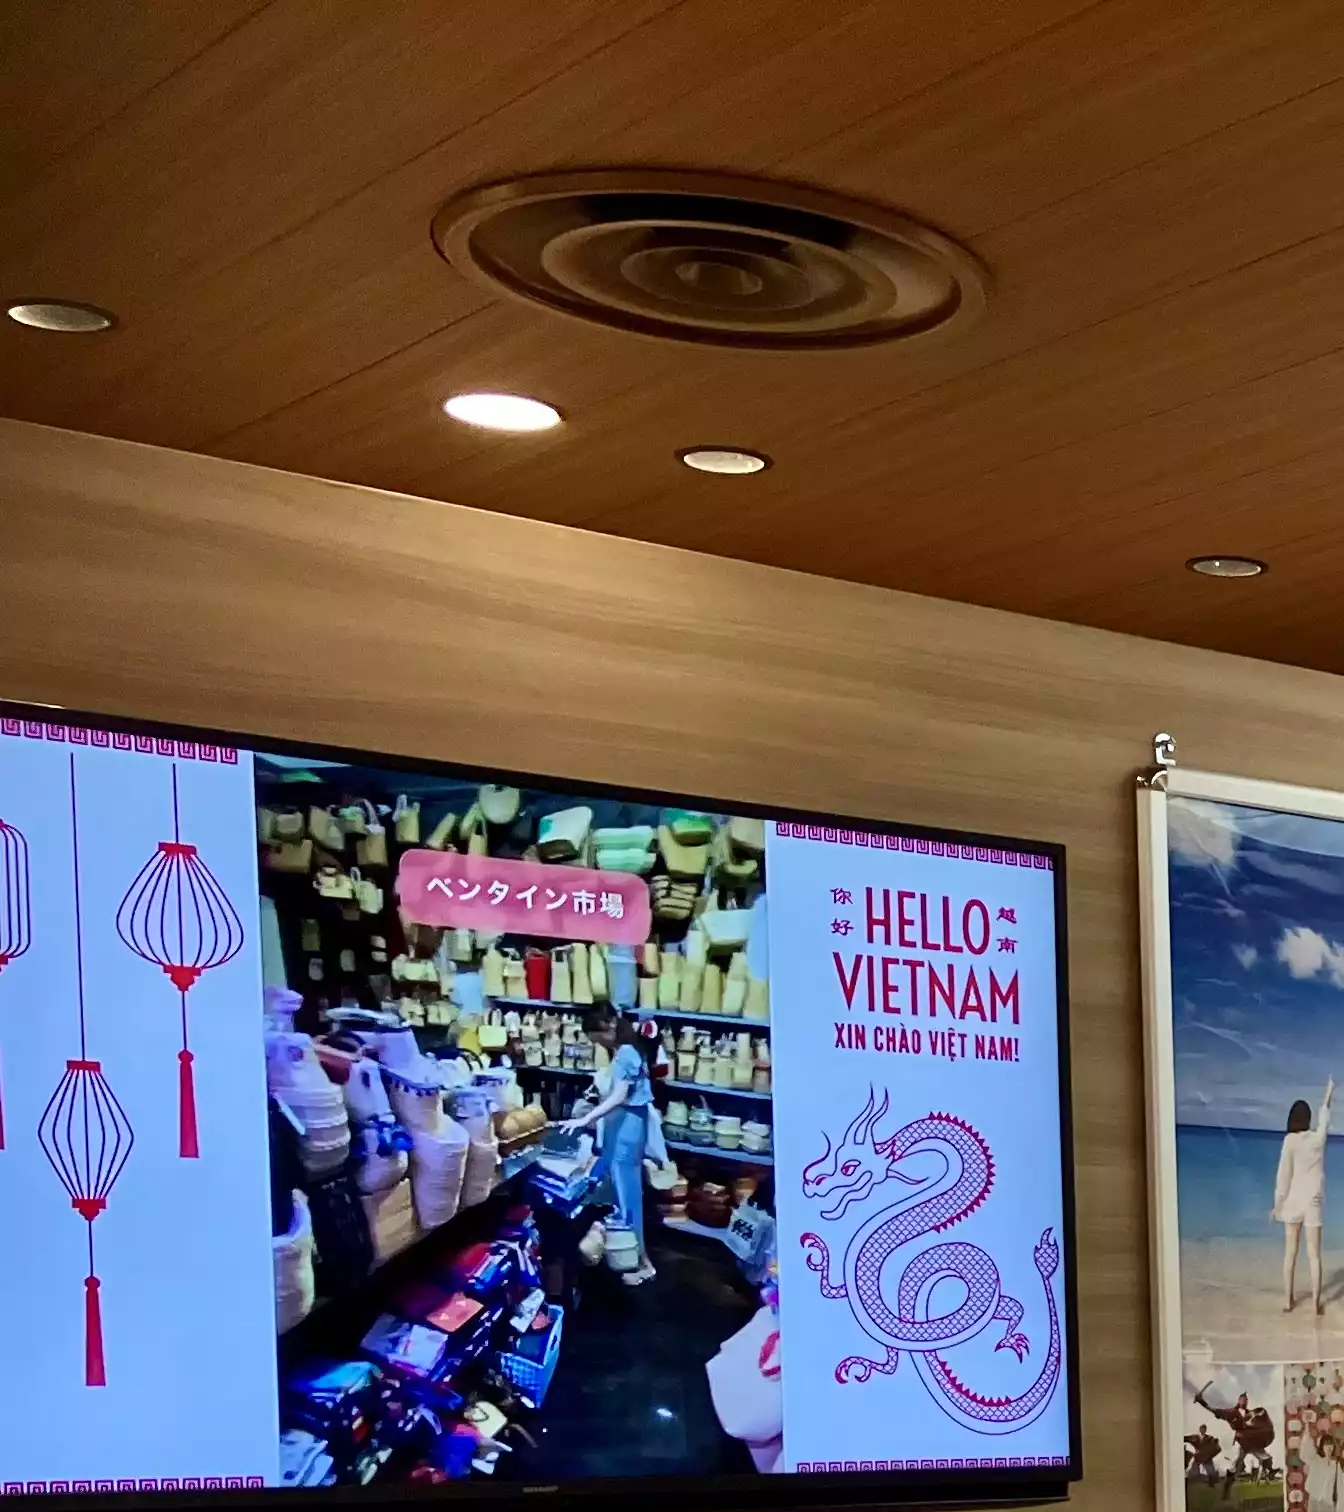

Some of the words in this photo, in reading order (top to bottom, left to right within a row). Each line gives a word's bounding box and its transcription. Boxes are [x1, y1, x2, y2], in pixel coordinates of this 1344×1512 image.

[426, 875, 626, 920] ベンタイン市場
[865, 886, 991, 955] HELLO
[832, 951, 1021, 1026] VIETNAM
[834, 1022, 867, 1050] XIN
[873, 1022, 922, 1055] CHÀO
[928, 1027, 968, 1062] VIỆT
[974, 1034, 1021, 1063] NAM!
